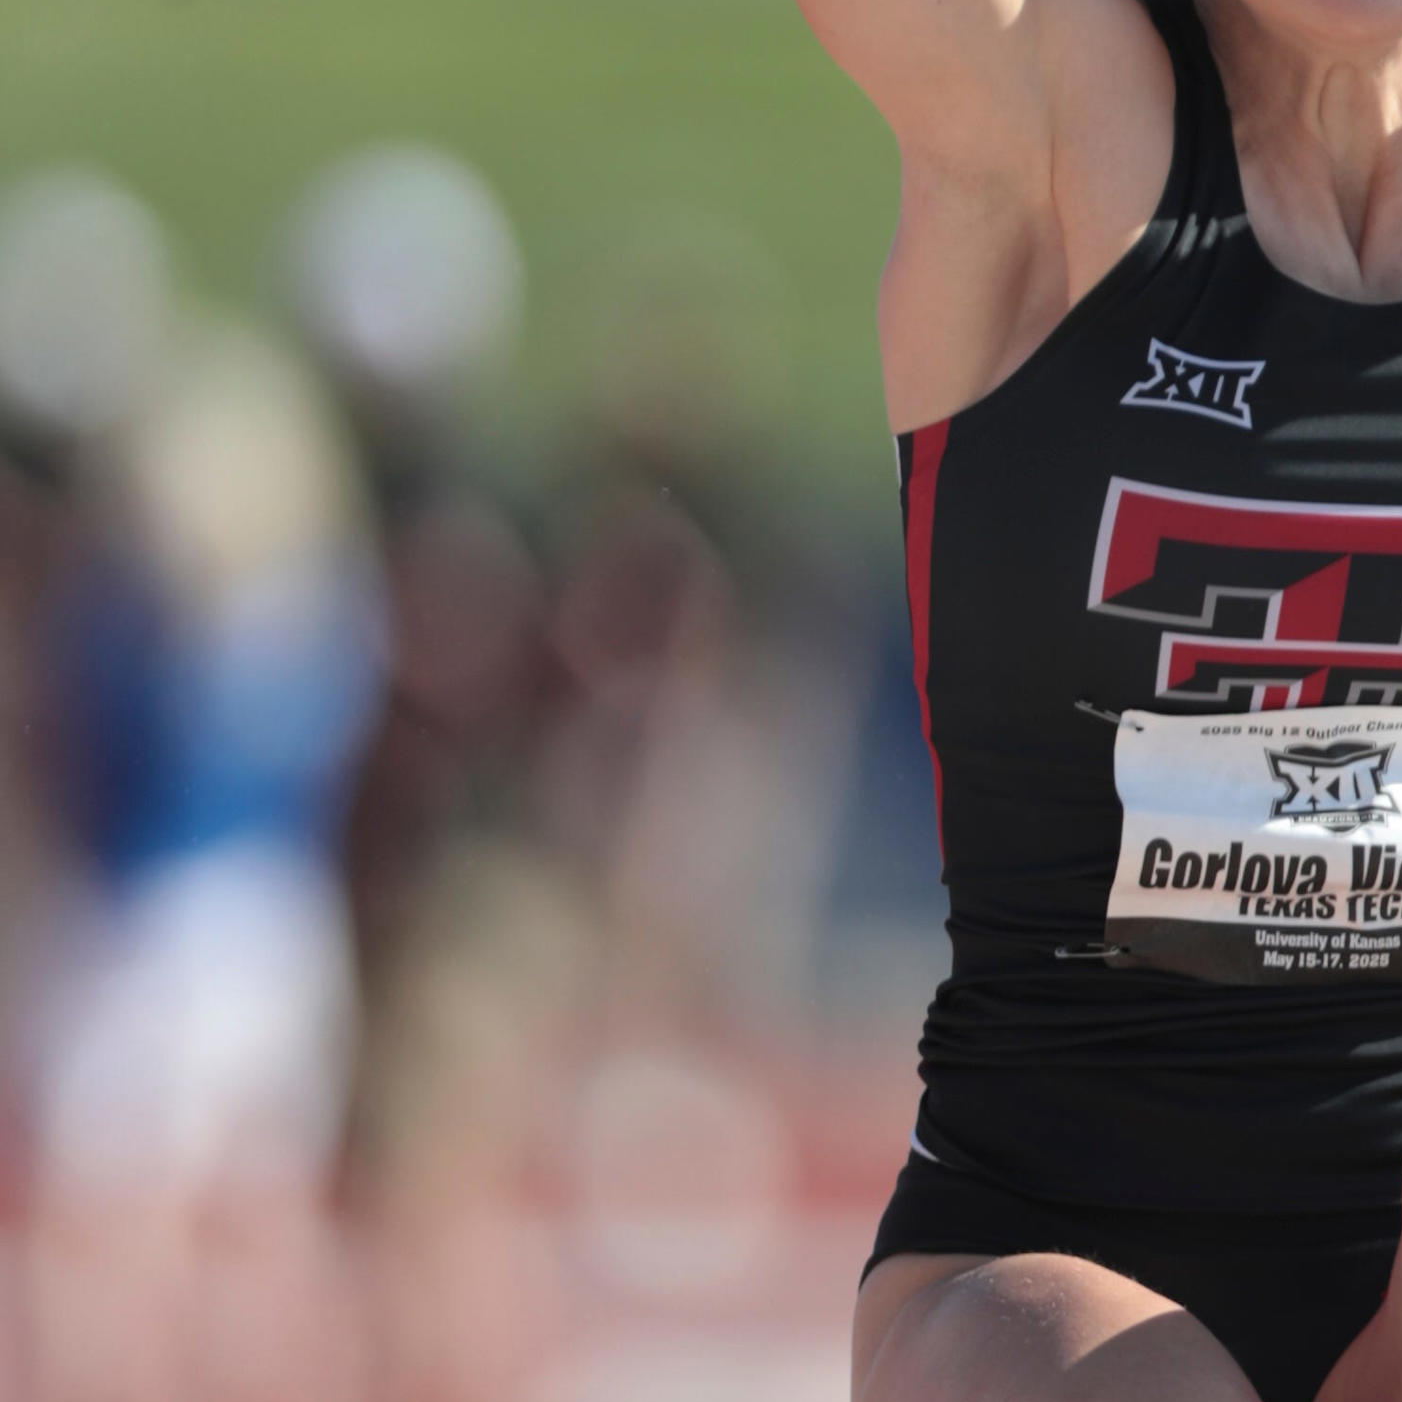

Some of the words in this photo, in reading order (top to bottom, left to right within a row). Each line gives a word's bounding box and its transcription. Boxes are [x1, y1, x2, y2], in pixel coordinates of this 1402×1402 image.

[1248, 724, 1275, 738] Big
[1282, 724, 1301, 737] 12
[1306, 723, 1361, 741] Outdoor
[1138, 837, 1329, 895] Gorlova
[1237, 892, 1337, 920] TEXAS
[1254, 929, 1329, 952] University
[1331, 930, 1347, 950] of
[1349, 931, 1402, 951] Kansas
[1263, 950, 1294, 971] May
[1348, 952, 1390, 969] 2025
